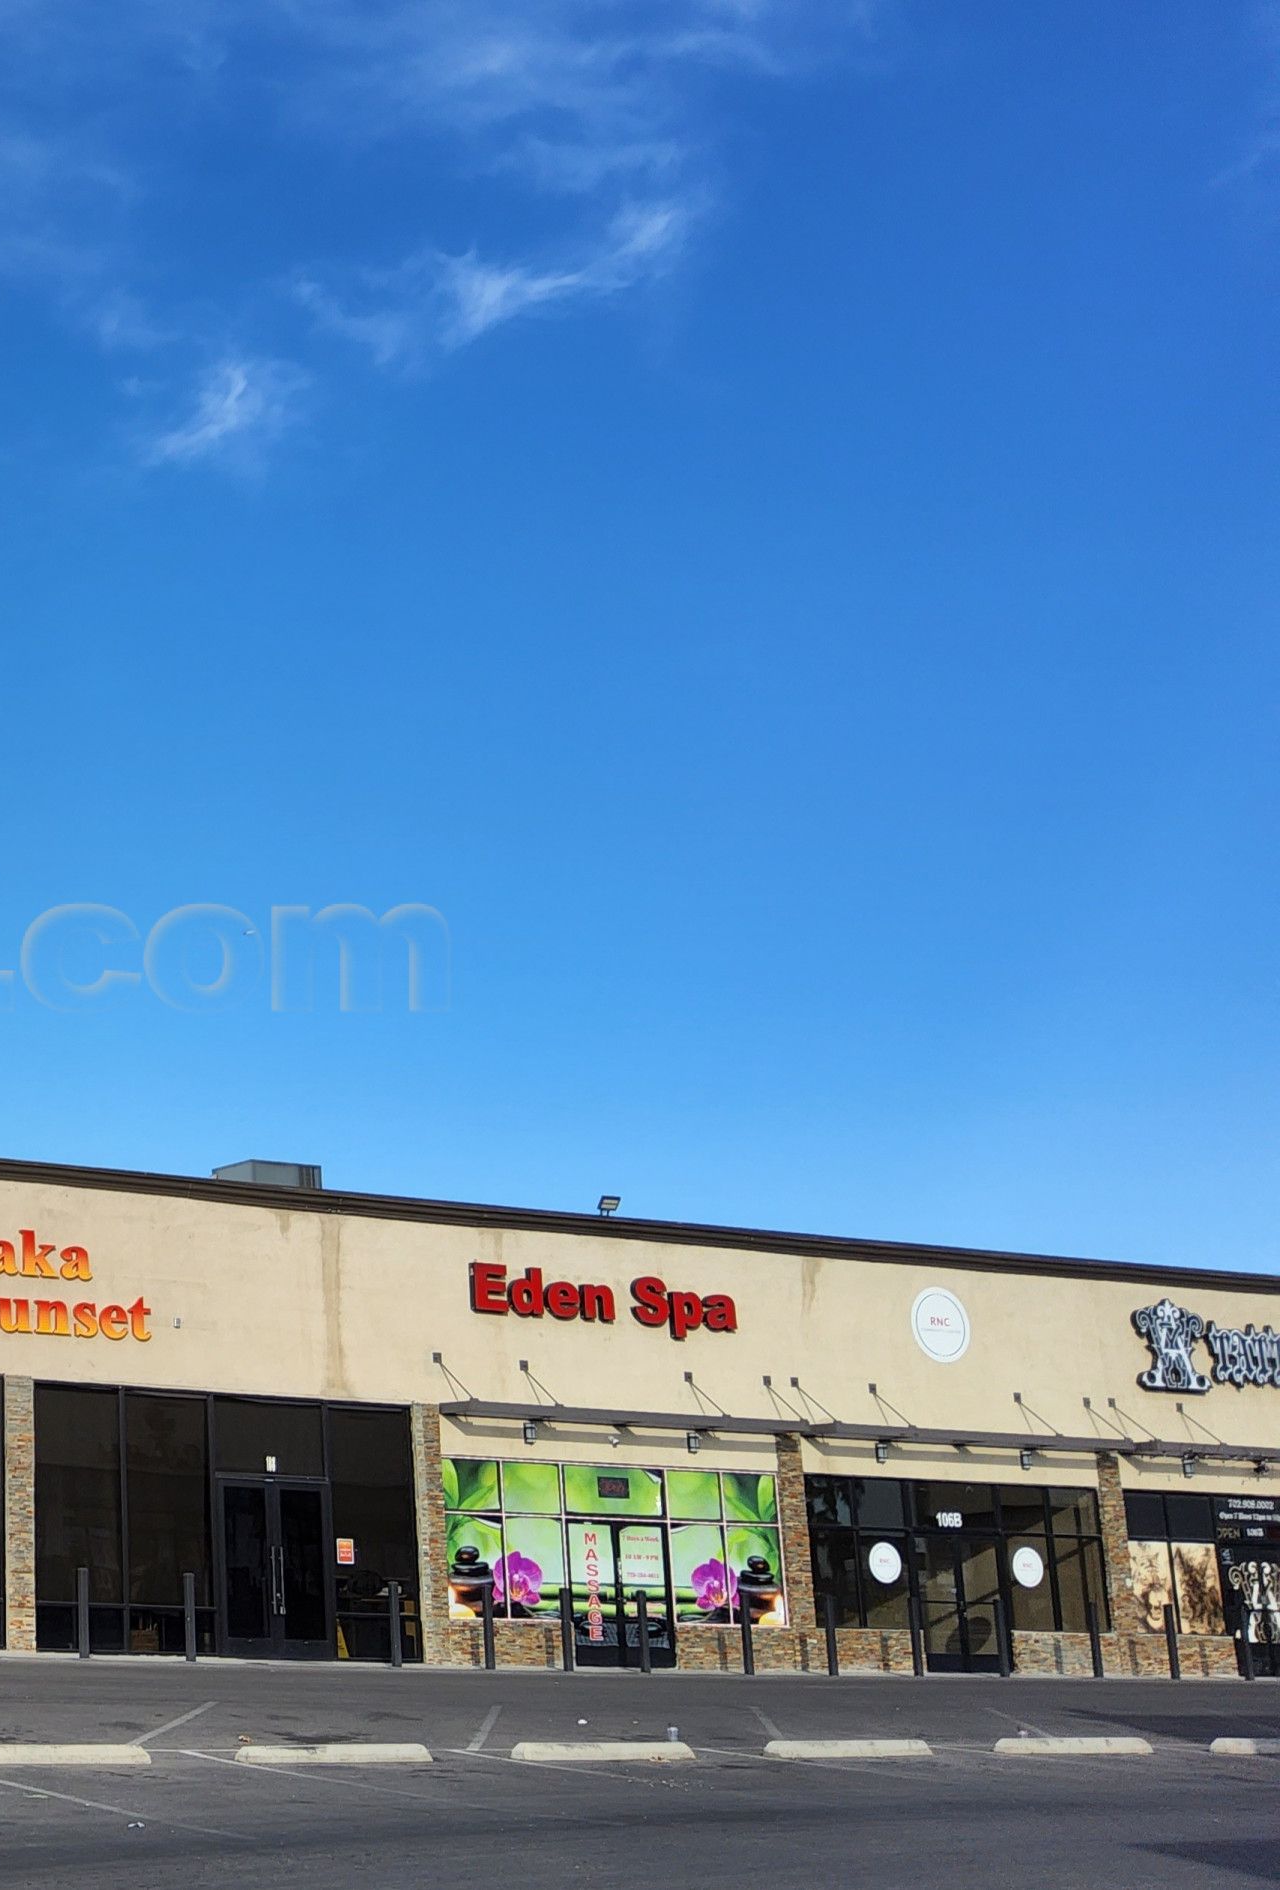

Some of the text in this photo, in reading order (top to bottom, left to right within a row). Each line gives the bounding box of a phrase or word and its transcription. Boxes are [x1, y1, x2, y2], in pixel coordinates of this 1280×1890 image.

[469, 1262, 739, 1341] Eden Spa
[930, 1317, 951, 1327] RNC
[935, 1512, 963, 1528] 106B
[584, 1532, 605, 1641] MASSAGE
